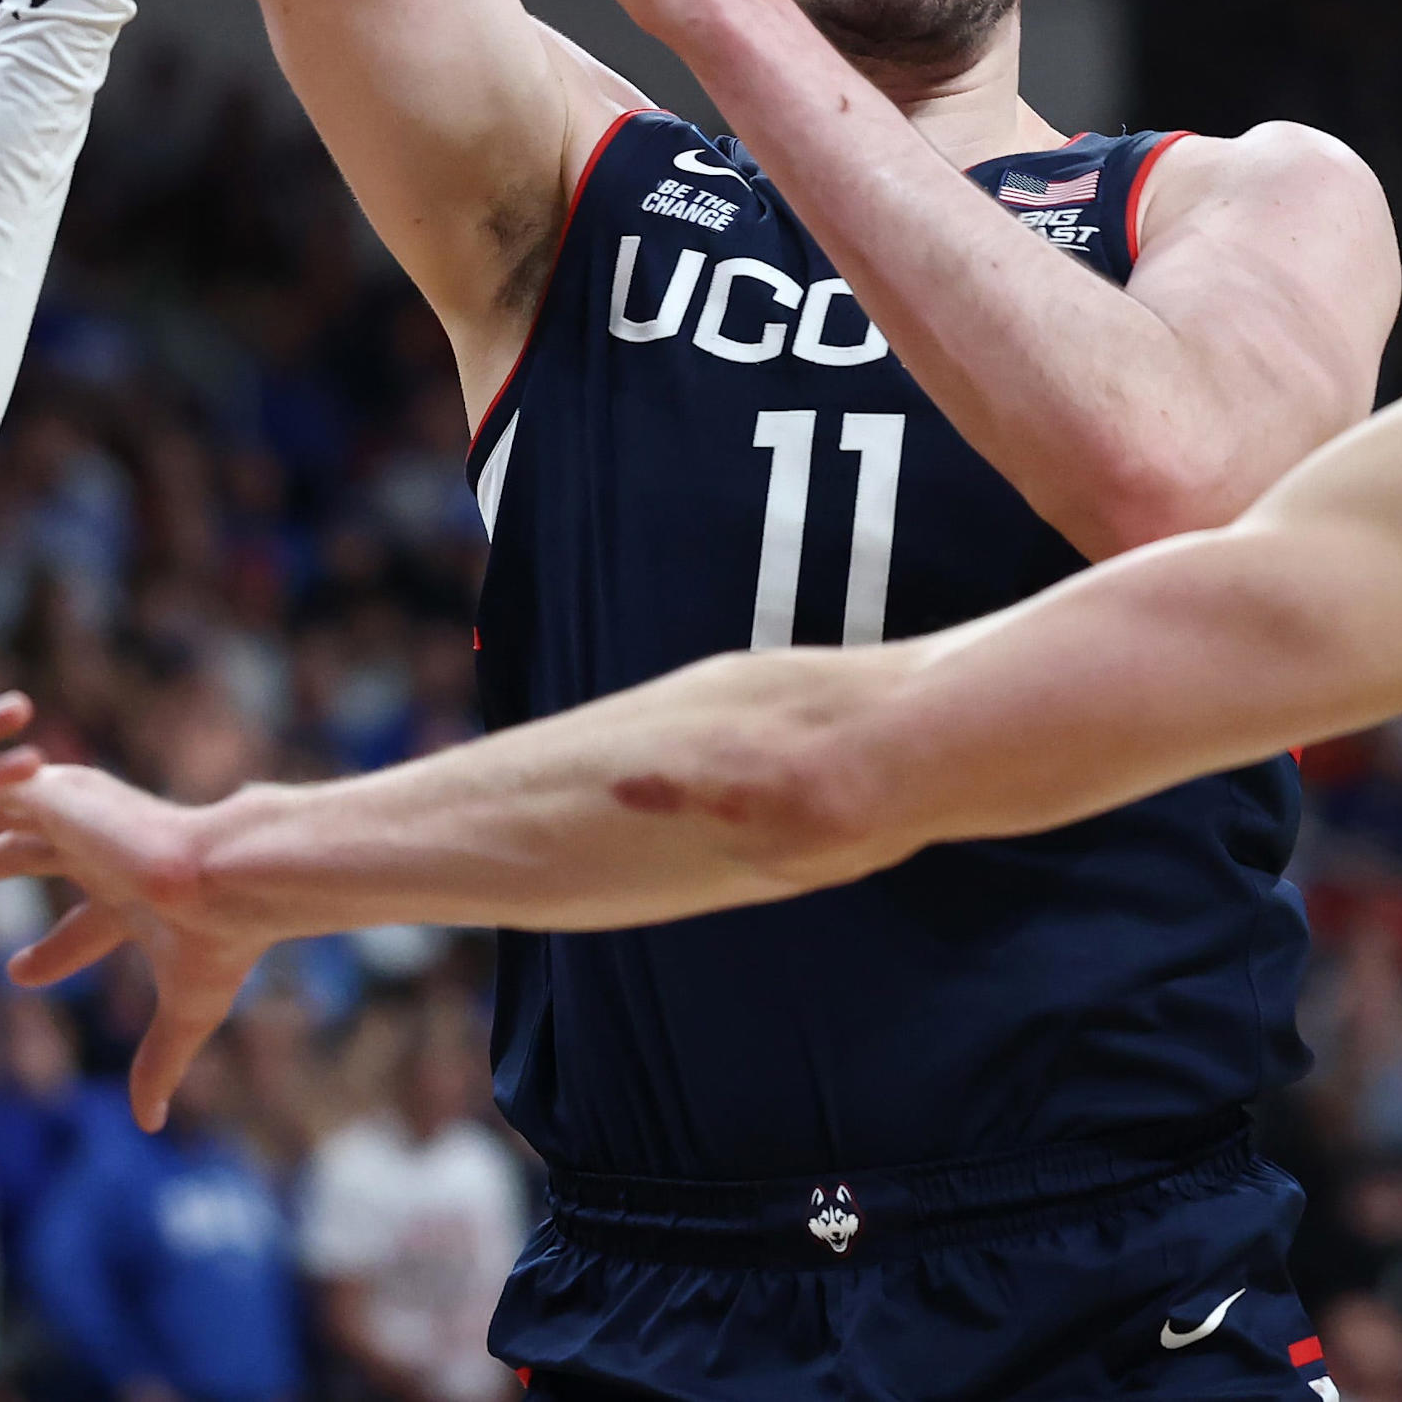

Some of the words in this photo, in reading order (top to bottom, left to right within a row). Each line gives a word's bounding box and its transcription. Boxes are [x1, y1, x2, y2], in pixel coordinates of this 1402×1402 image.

[641, 192, 734, 232] CHANGE
[656, 178, 694, 199] BE
[693, 190, 741, 215] THE
[608, 235, 889, 367] UCO
[750, 409, 906, 652] 11
